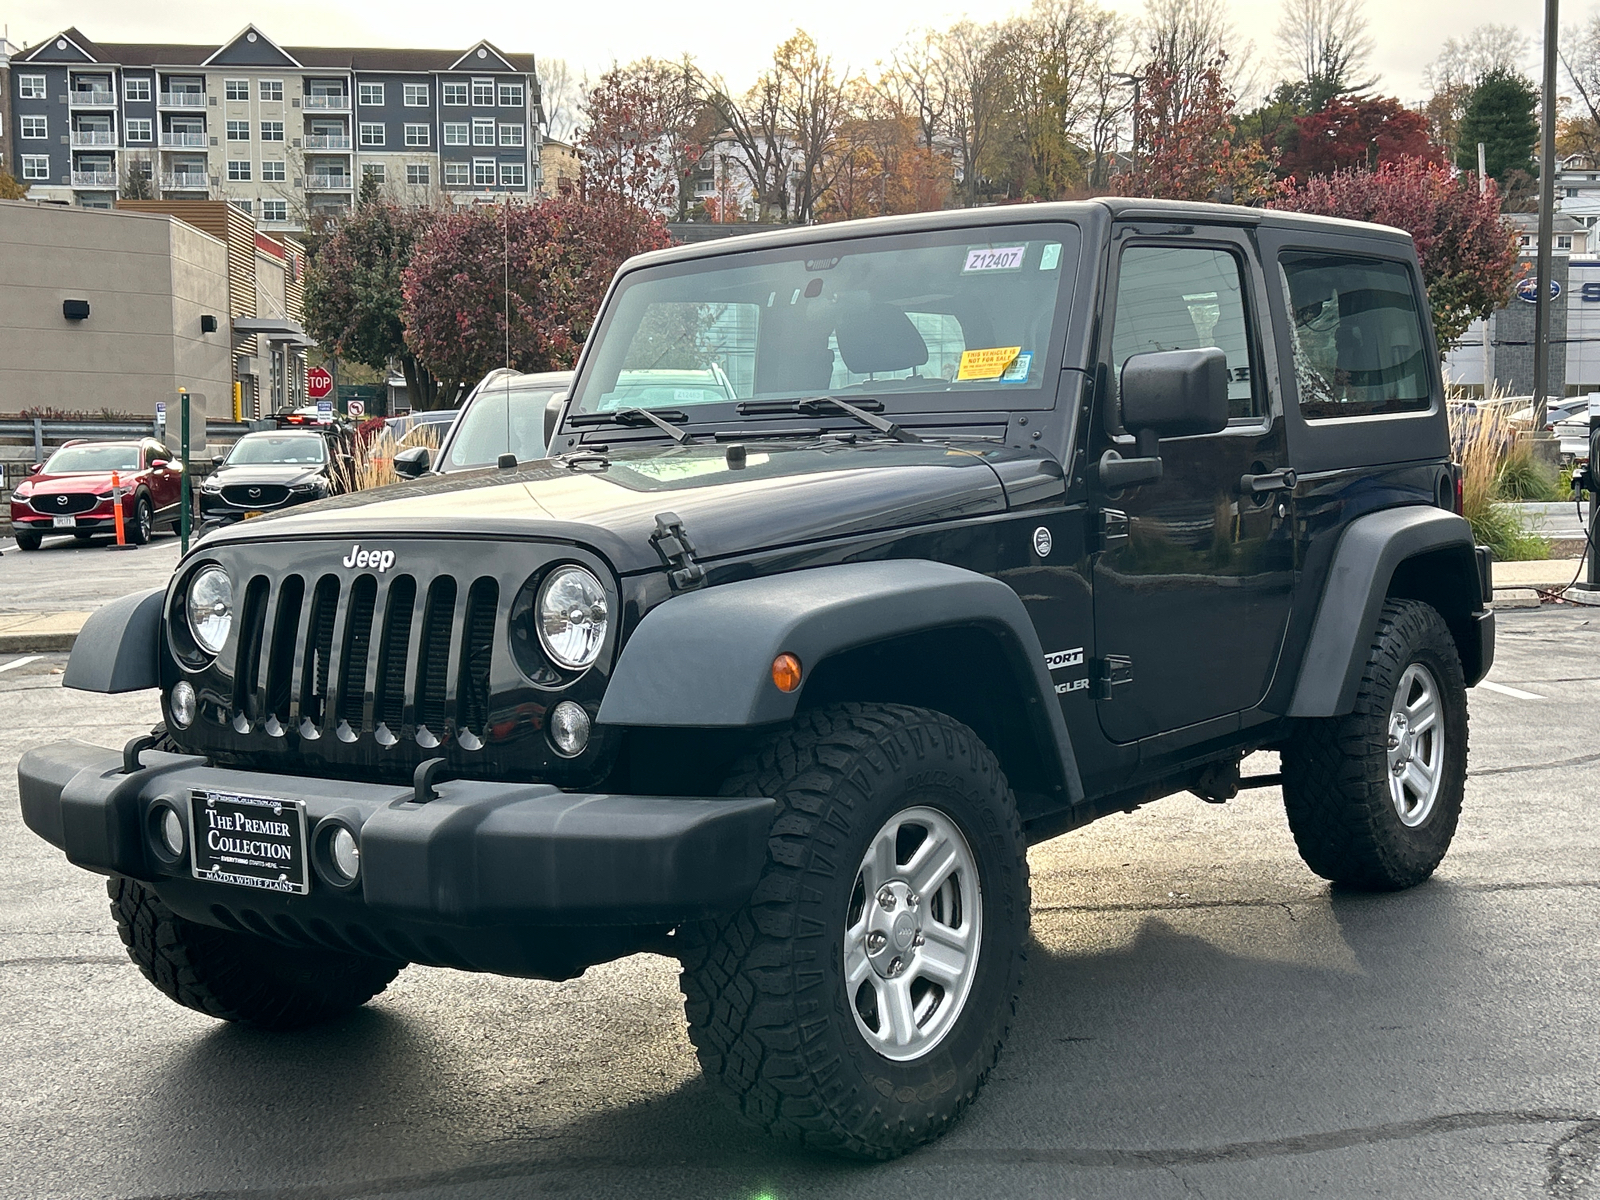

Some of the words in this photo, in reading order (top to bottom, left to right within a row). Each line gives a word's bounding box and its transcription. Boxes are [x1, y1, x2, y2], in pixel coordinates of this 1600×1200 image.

[969, 253, 1018, 268] Z12407
[982, 349, 1008, 357] VEHICLE
[309, 376, 331, 389] TOP
[342, 544, 396, 573] Jeep
[1045, 651, 1084, 665] PORT
[205, 808, 234, 830] THE
[234, 812, 291, 837] PREMIER
[207, 829, 292, 860] COLLECTION
[206, 872, 235, 883] MAZDA
[236, 876, 263, 888] WHITE
[264, 879, 294, 893] PLAINS
